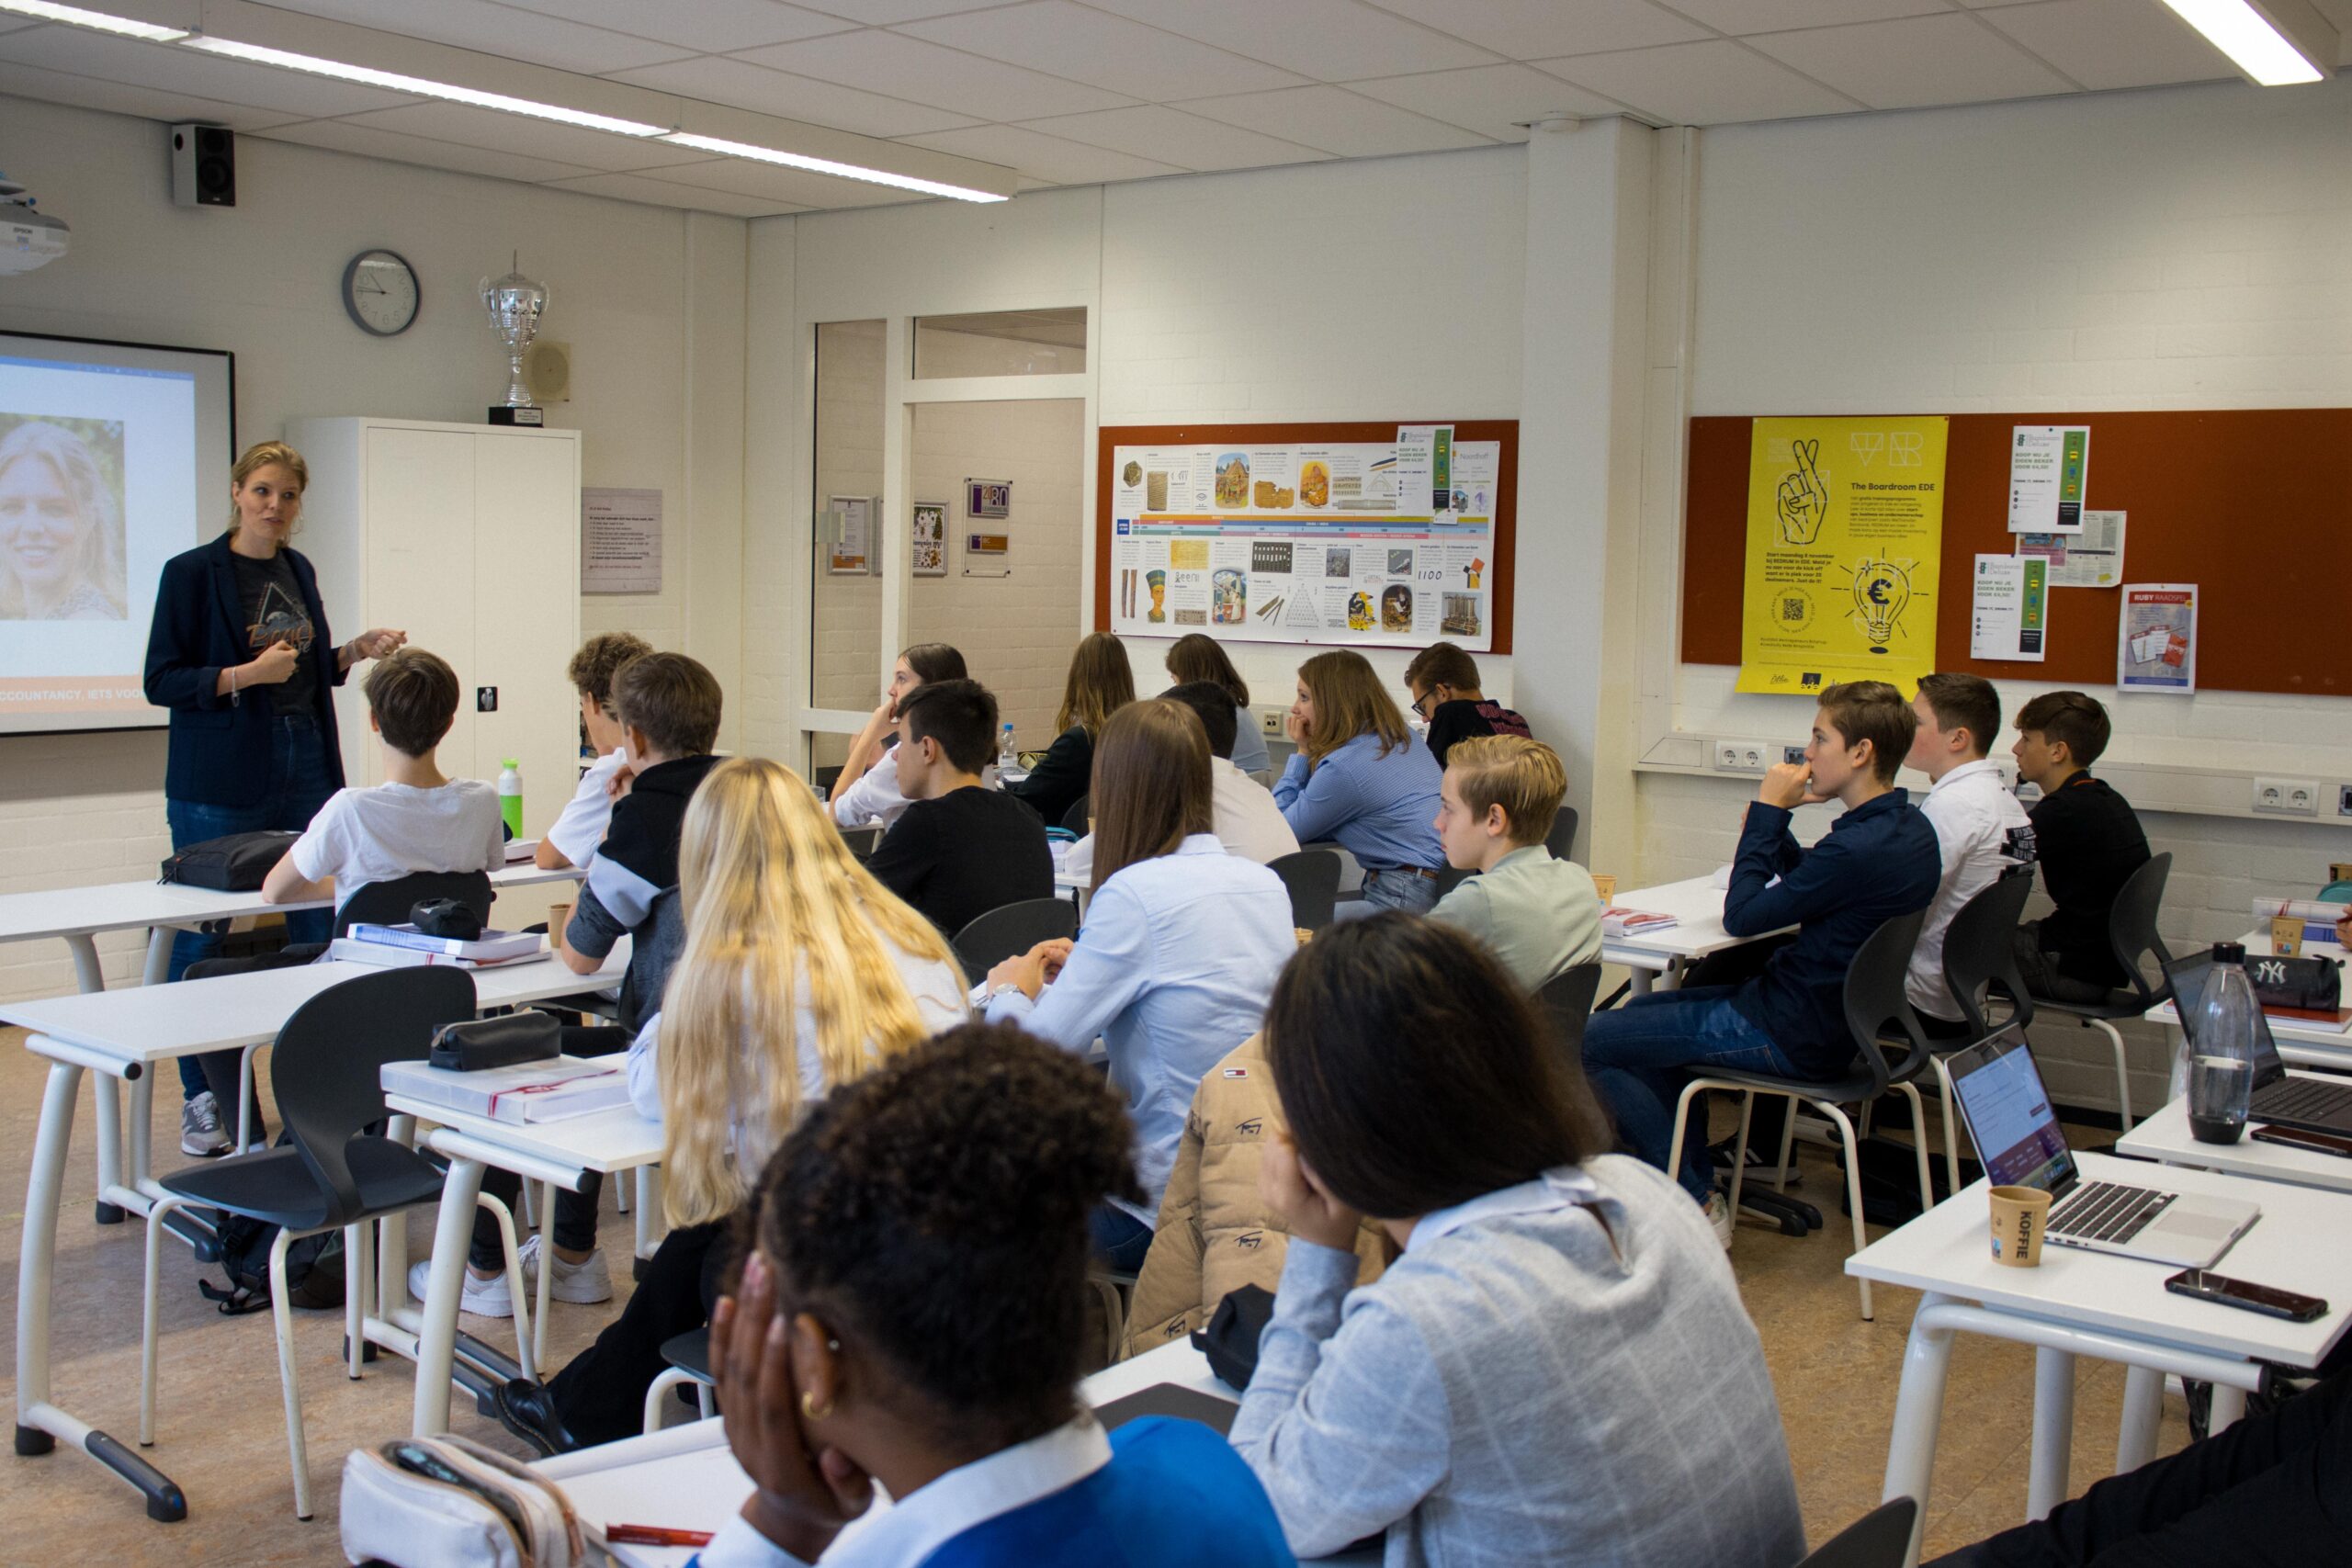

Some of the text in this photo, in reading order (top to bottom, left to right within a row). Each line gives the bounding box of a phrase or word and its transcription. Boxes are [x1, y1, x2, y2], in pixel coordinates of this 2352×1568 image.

[1460, 452, 1489, 460] Noordhoff
[1851, 482, 1936, 491] The Boardroom EDE
[991, 487, 1008, 506] 80
[1418, 570, 1442, 581] 1100
[1800, 682, 1819, 690] ede
[87, 689, 113, 700] IETS
[2016, 1210, 2032, 1259] KOFFIE
